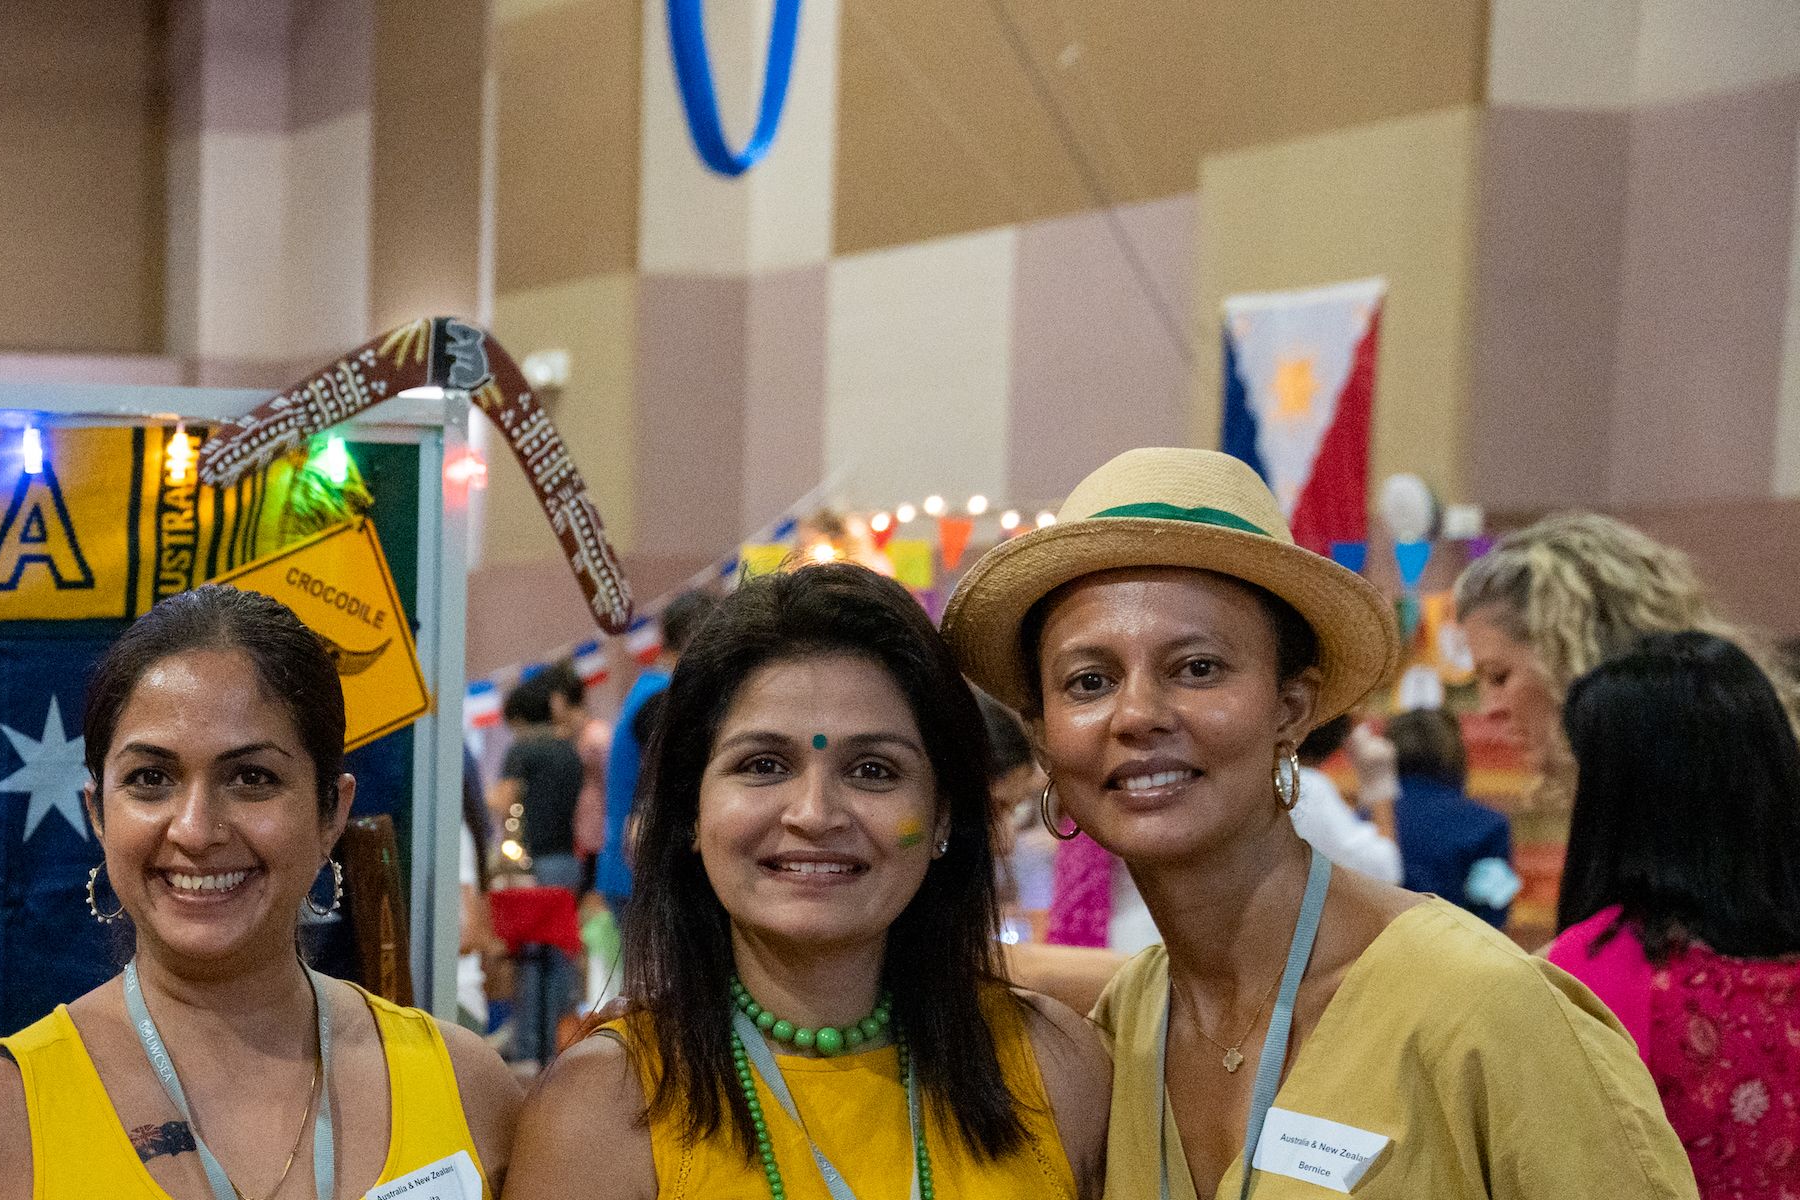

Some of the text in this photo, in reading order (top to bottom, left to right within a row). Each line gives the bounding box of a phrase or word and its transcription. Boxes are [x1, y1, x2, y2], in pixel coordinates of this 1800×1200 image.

[286, 567, 387, 631] CROCODILE
[146, 1036, 172, 1083] UWCSEA
[1280, 1133, 1309, 1147] Australia
[1311, 1140, 1317, 1149] &
[1319, 1143, 1338, 1155] New
[1298, 1160, 1332, 1177] Bernice
[408, 1182, 415, 1190] &
[414, 1176, 431, 1188] New
